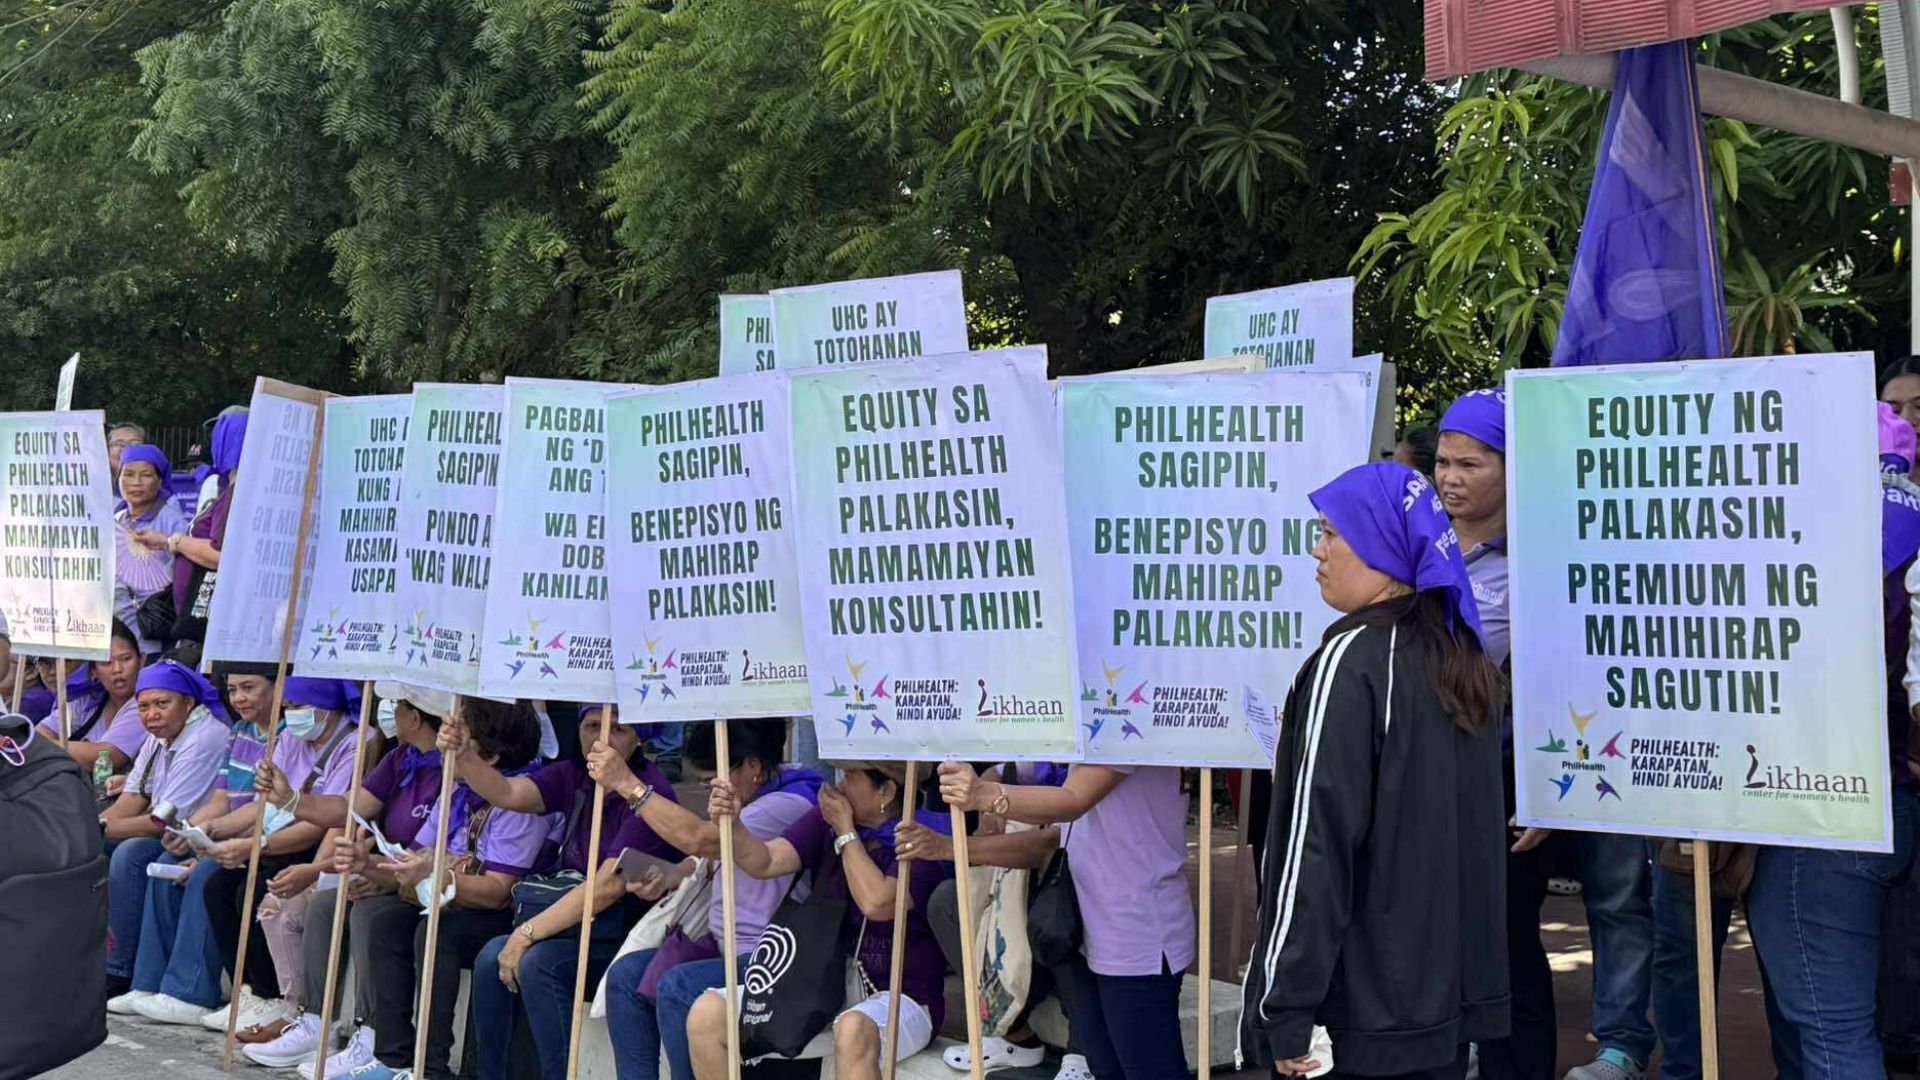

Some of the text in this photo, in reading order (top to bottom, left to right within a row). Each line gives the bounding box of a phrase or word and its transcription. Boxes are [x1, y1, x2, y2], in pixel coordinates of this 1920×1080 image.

[832, 301, 898, 332] UHC AY
[1249, 308, 1300, 340] UHC AY
[814, 330, 922, 365] TOTOHANAN
[843, 383, 991, 433] EQUITY SA
[1588, 389, 1783, 439] EQUITY NG
[370, 418, 397, 442] UHC
[642, 400, 764, 447] PHILHEALTH
[1115, 405, 1304, 443] PHILHEALTH
[14, 431, 81, 456] EQUITY SA
[546, 437, 573, 461] NG
[658, 442, 750, 483] SAGIPIN,
[836, 434, 1008, 483] PHILHEALTH
[1576, 441, 1800, 489] PHILHEALTH
[9, 463, 89, 487] PHILHEALTH
[549, 468, 591, 493] ANG
[1138, 451, 1278, 493] SAGIPIN,
[357, 478, 390, 502] KUNG
[10, 494, 92, 520] PALAKASIN,
[839, 487, 1015, 534] PALAKASIN,
[1577, 495, 1802, 545] PALAKASIN,
[426, 509, 476, 546] PONDO
[545, 513, 577, 538] WA
[632, 497, 782, 544] BENEPISYO NG
[5, 525, 99, 550] MAMAMAYAN
[1094, 517, 1319, 556] BENEPISYO NG
[5, 557, 102, 582] KONSULTAHIN!
[660, 540, 760, 580] MAHIRAP
[829, 537, 1035, 585] MAMAMAYAN
[1132, 564, 1283, 602] MAHIRAP
[1568, 562, 1819, 608] PREMIUM NG
[648, 580, 777, 621] PALAKASIN!
[829, 590, 1044, 636] KONSULTAHIN!
[1113, 609, 1303, 649] PALAKASIN!
[1584, 615, 1802, 661] MAHIHIRAP
[567, 659, 596, 670] HINDI
[680, 650, 729, 664] PHILHEALTH:
[681, 664, 725, 676] KARAPATAN,
[681, 675, 731, 687] HINDI AYUDA!
[894, 679, 959, 694] PHILHEALTH:
[1606, 666, 1781, 715] SAGUTIN!
[845, 703, 878, 711] PhilHealth
[895, 693, 953, 708] KARAPATAN,
[976, 679, 1064, 717] Likhaan
[1153, 687, 1228, 702] PHILHEALTH:
[896, 706, 962, 721] HINDI AYUDA!
[999, 716, 1011, 724] for
[1042, 715, 1065, 723] health
[1093, 707, 1131, 716] PhilHealth
[1152, 702, 1220, 716] KARAPATAN,
[1152, 715, 1229, 729] HINDI AYUDA!
[1630, 738, 1720, 758] PHILHEALTH:
[1561, 760, 1606, 772] PhilHealth
[1630, 757, 1713, 777] KARAPATAN,
[1743, 744, 1870, 795] Likhaan
[1632, 773, 1723, 792] HINDI AYUDA!
[1742, 788, 1871, 804] center for women's health
